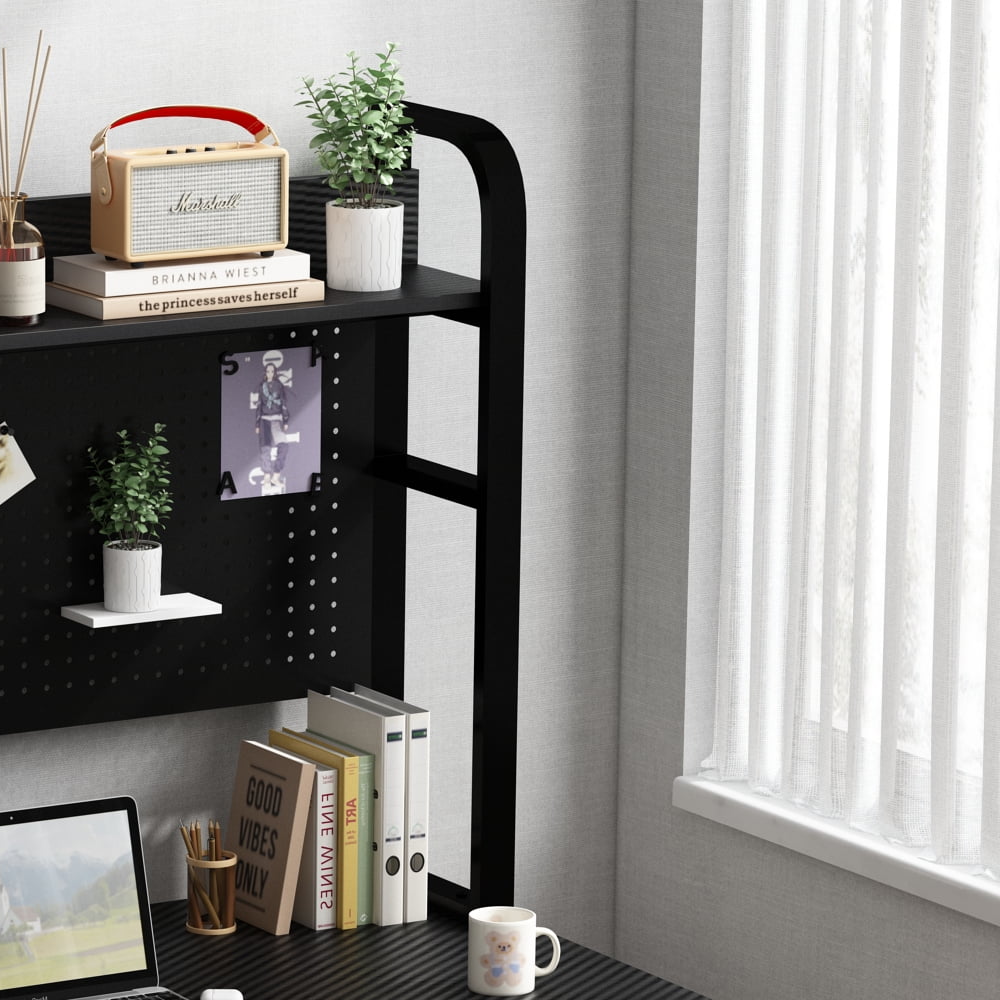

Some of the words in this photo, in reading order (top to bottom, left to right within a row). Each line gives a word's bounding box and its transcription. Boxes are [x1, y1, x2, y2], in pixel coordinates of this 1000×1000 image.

[170, 191, 242, 214] Marshall
[152, 271, 218, 286] BRIANNA
[225, 266, 267, 279] WIEST
[139, 300, 160, 312] the
[162, 294, 216, 312] princess
[218, 292, 251, 305] saves
[254, 287, 299, 303] herself
[246, 775, 283, 817] GOOD
[239, 815, 278, 860] VIBES
[235, 860, 269, 899] ONLY
